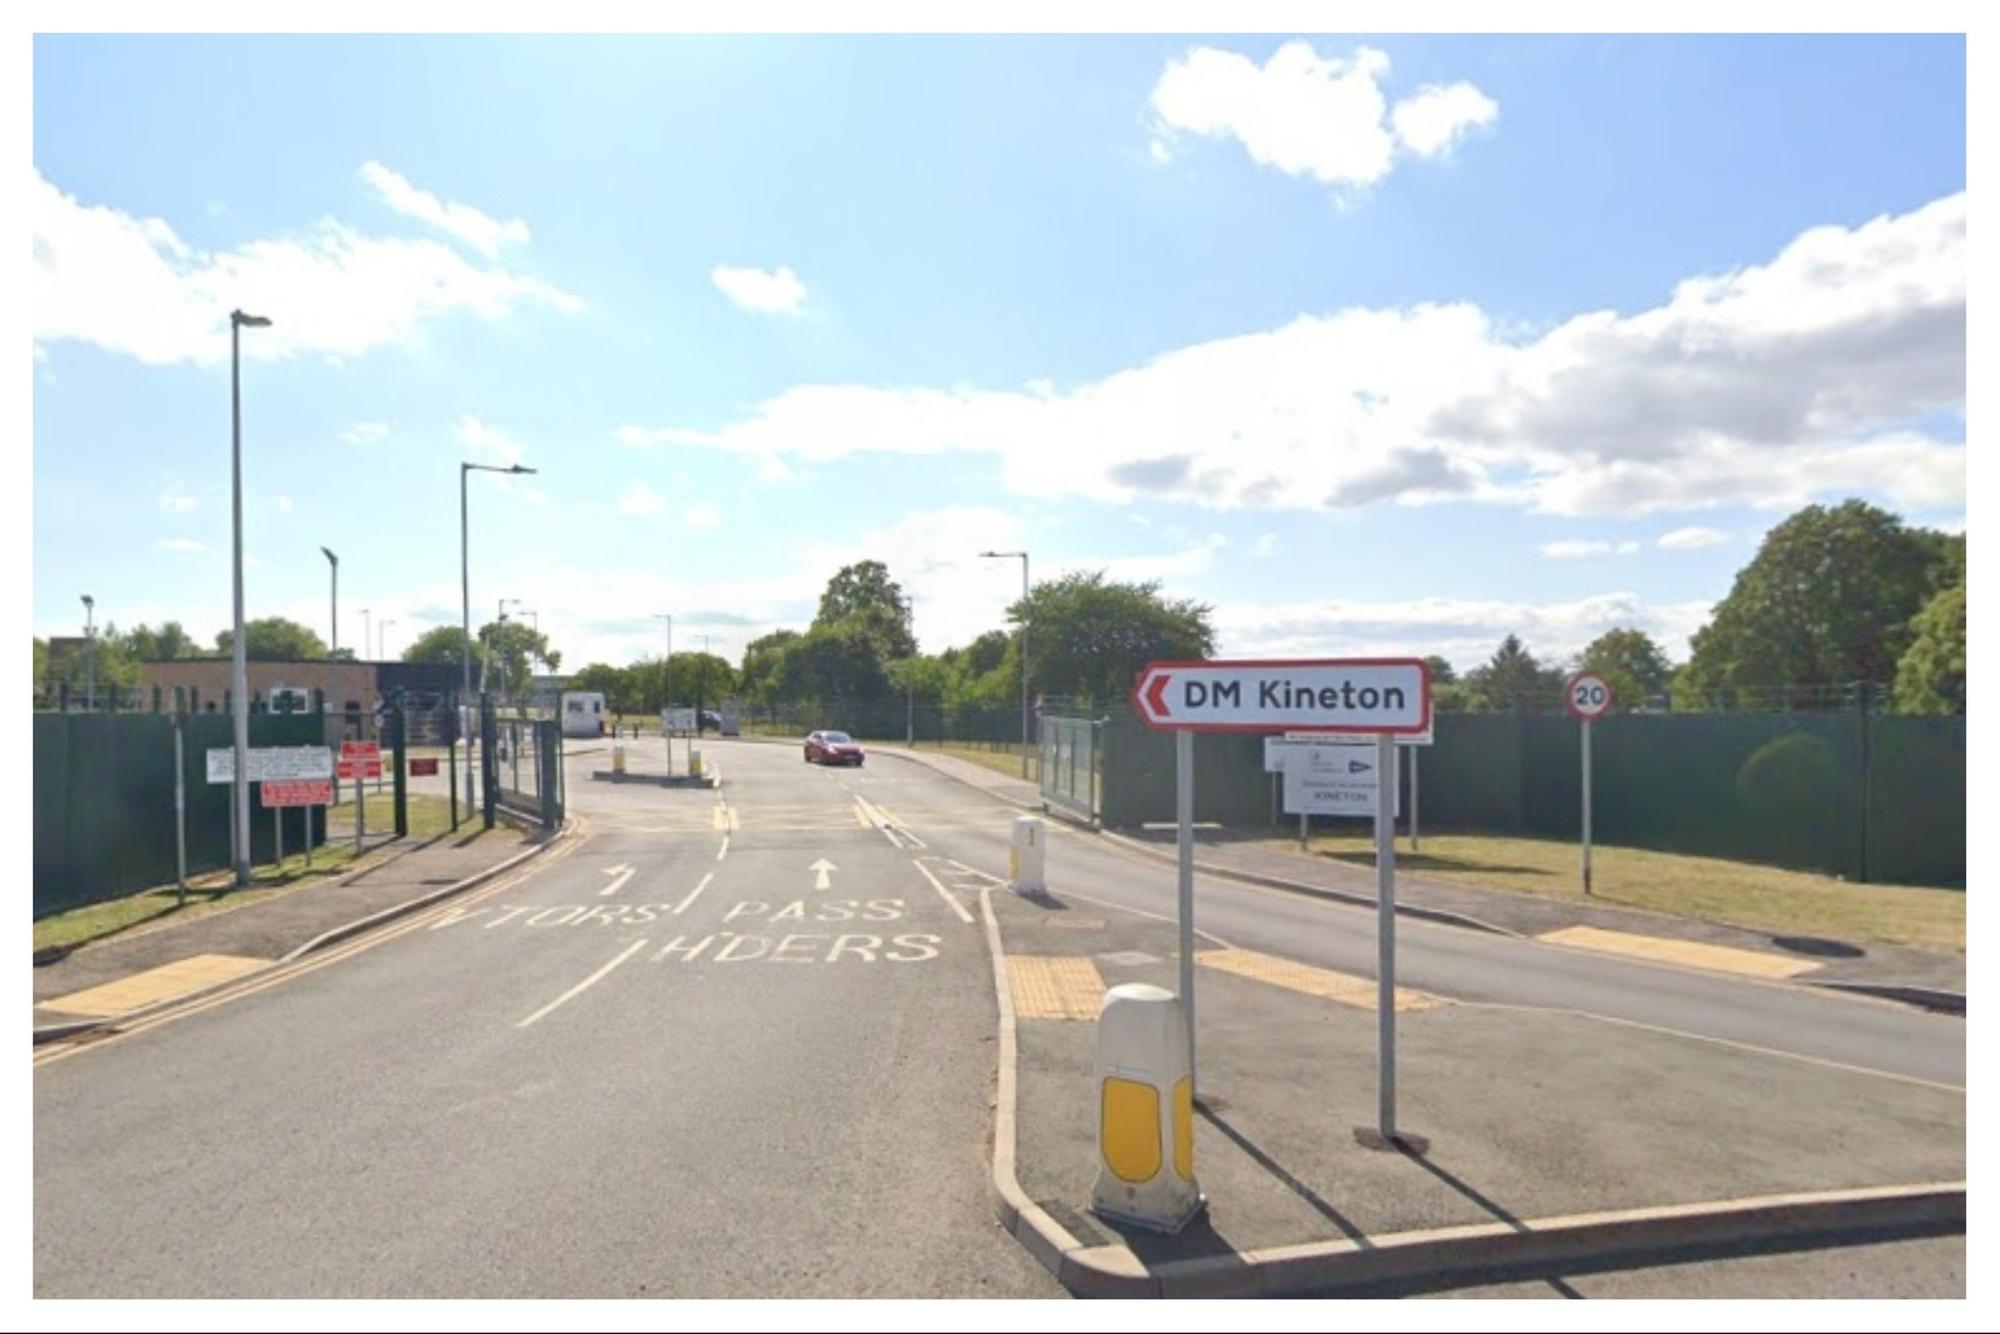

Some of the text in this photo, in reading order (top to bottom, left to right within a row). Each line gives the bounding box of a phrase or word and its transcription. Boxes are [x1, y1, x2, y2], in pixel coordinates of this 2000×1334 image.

[1184, 680, 1405, 709] DM Kineton
[1576, 685, 1606, 706] 20
[722, 899, 905, 924] PASS
